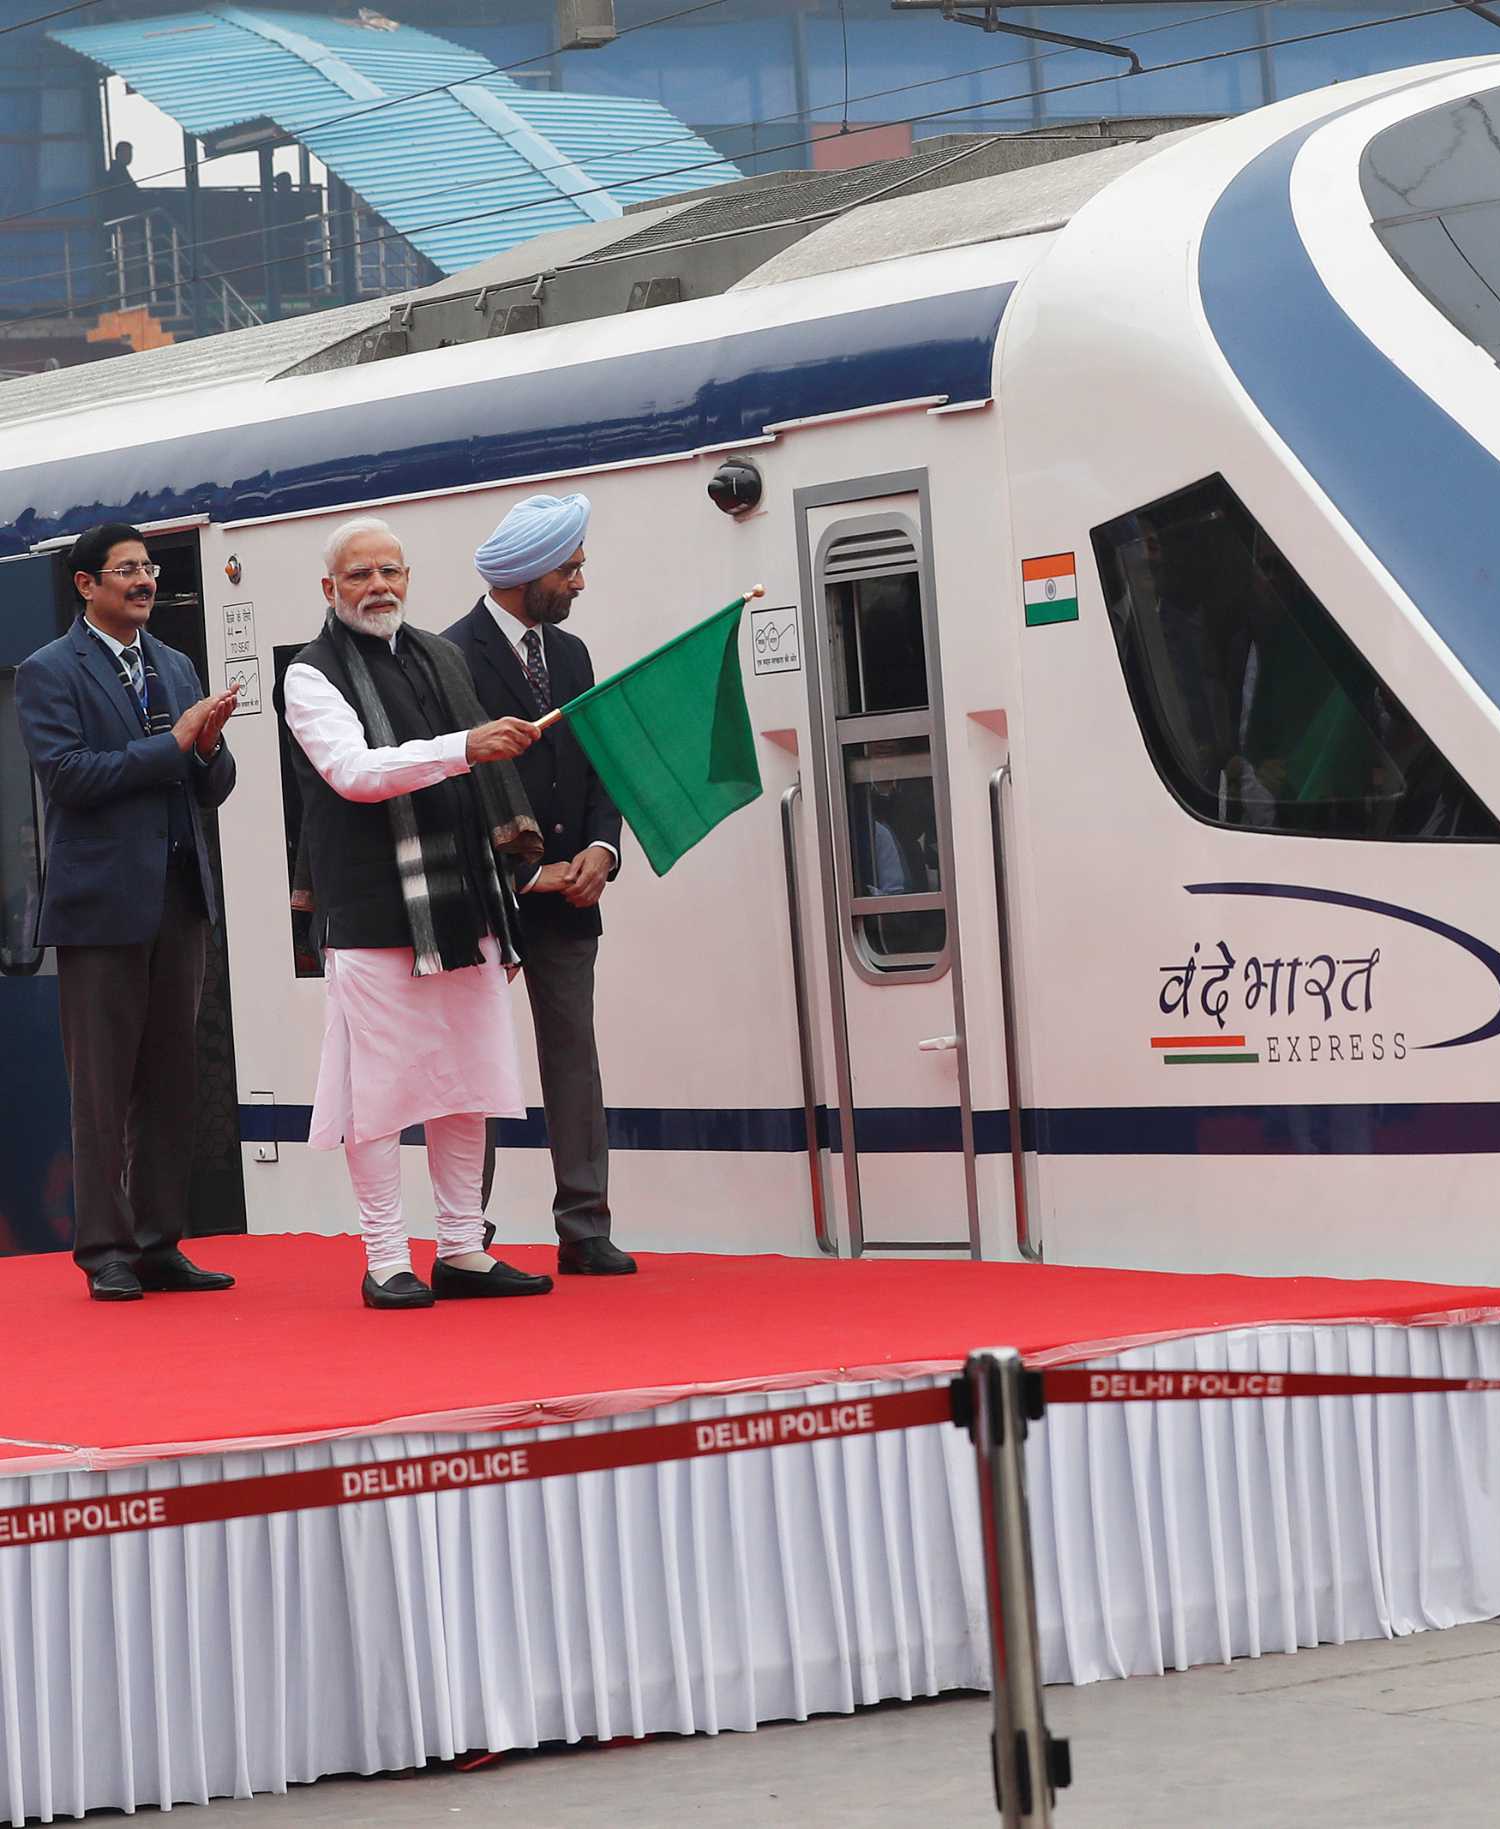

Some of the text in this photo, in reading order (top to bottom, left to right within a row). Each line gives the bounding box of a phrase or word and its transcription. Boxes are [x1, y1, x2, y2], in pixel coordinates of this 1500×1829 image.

[1158, 940, 1381, 1030] वंदे भारत
[1266, 1032, 1408, 1064] EXPRESS
[1089, 1374, 1283, 1397] DELHI POLICE
[696, 1403, 875, 1451] DELHI POLICE
[342, 1449, 529, 1497] DELHI POLICE
[0, 1496, 167, 1542] ELHI POLICE
